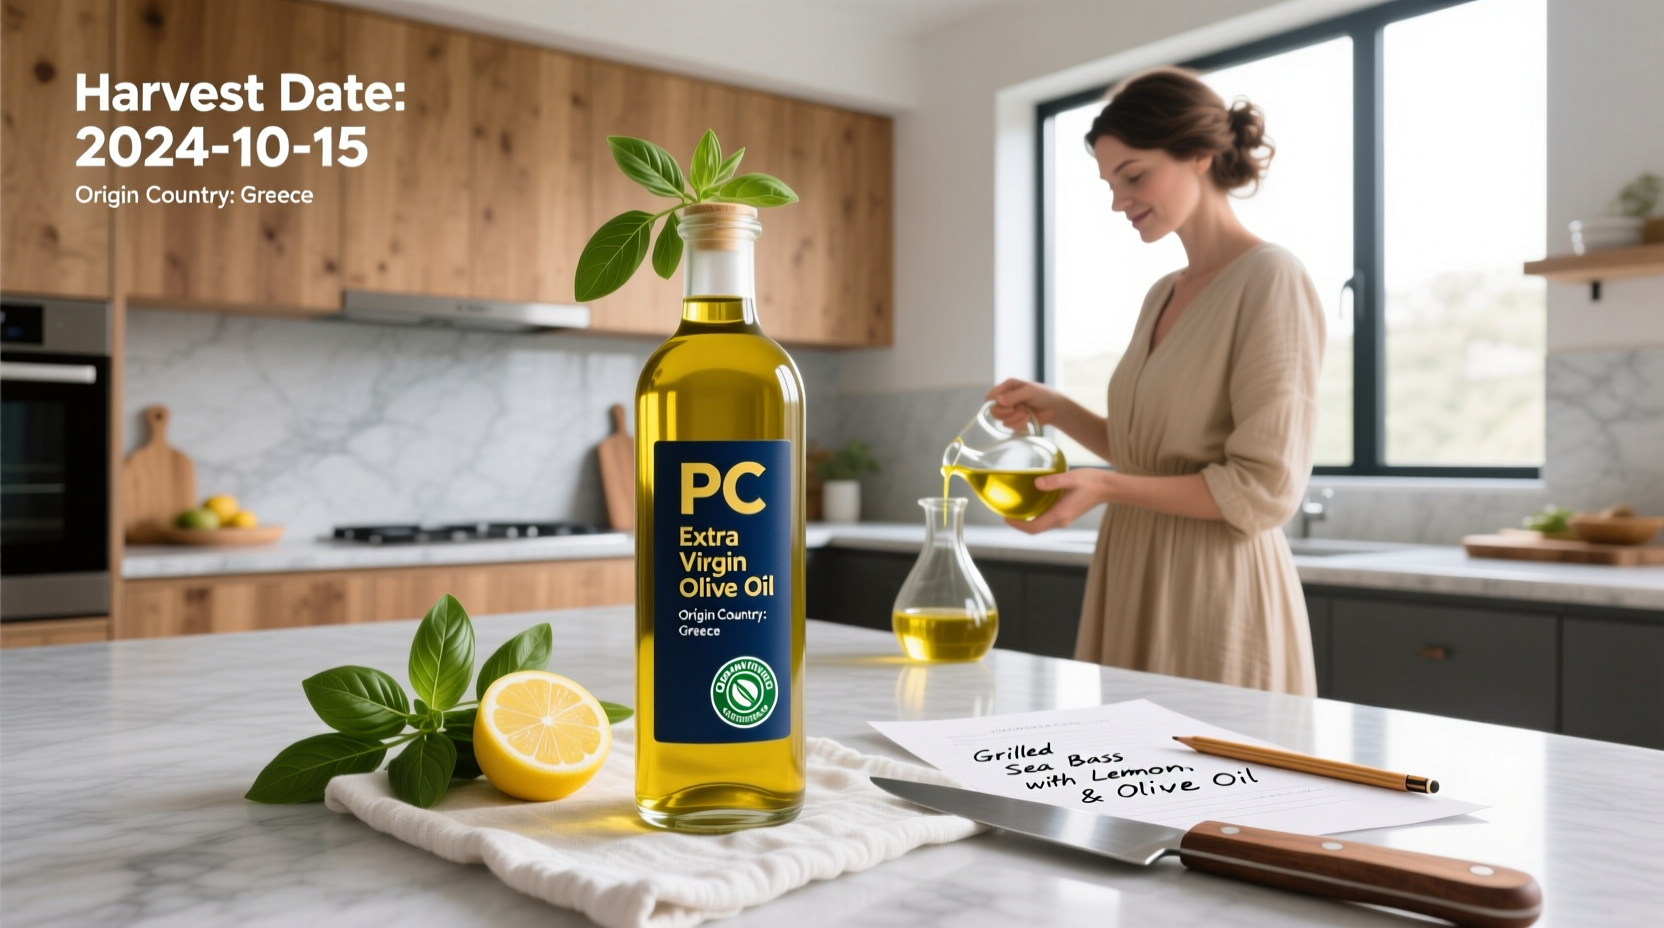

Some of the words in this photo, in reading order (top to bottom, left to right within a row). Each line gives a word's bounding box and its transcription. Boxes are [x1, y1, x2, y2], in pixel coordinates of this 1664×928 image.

[680, 461, 767, 515] PC
[680, 526, 739, 547] Extra
[679, 551, 747, 577] Virgin
[679, 577, 738, 598] Olive
[744, 574, 774, 597] Oil
[678, 608, 715, 623] Origin
[717, 608, 767, 623] Country:
[973, 742, 1054, 762] Grilled
[1005, 763, 1055, 775] Sea
[1068, 752, 1124, 767] Bass
[1026, 773, 1077, 790] with
[1081, 788, 1104, 804] &
[1117, 780, 1201, 798] Olive
[1212, 767, 1259, 787] Oil
